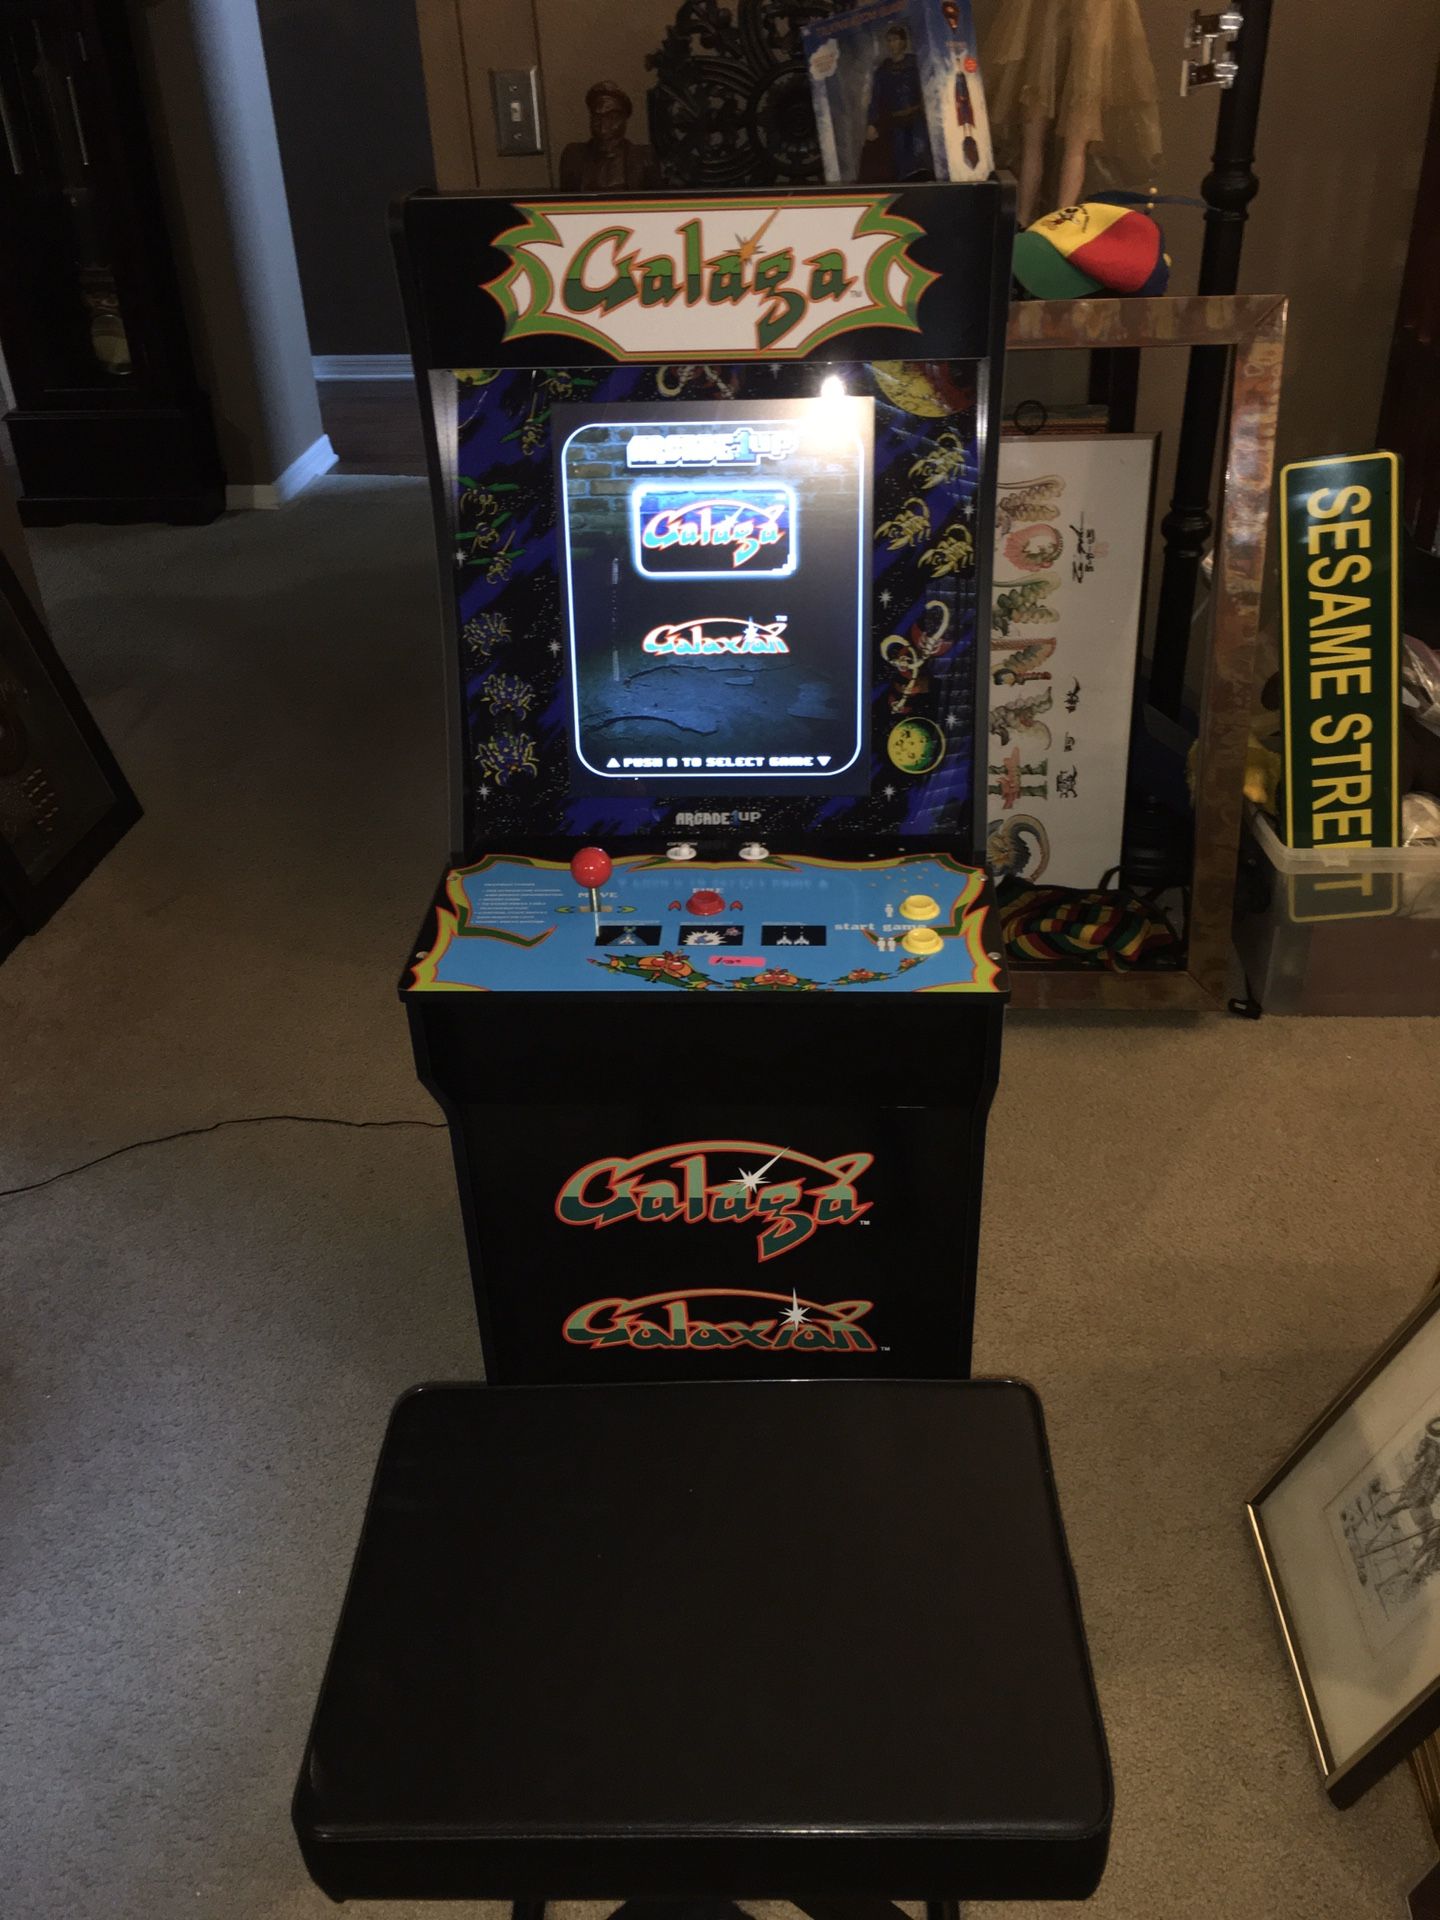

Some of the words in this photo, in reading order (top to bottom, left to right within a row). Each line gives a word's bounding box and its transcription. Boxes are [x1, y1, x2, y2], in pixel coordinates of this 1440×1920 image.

[562, 217, 858, 355] Galaga
[642, 499, 785, 568] Galaga
[1306, 484, 1373, 700] SESAME
[642, 617, 789, 656] Galaxian
[706, 757, 765, 767] SELECT
[1310, 713, 1373, 897] STRET
[835, 922, 875, 931] start
[555, 1139, 875, 1263] Galaga
[562, 1287, 877, 1351] Galaxian
